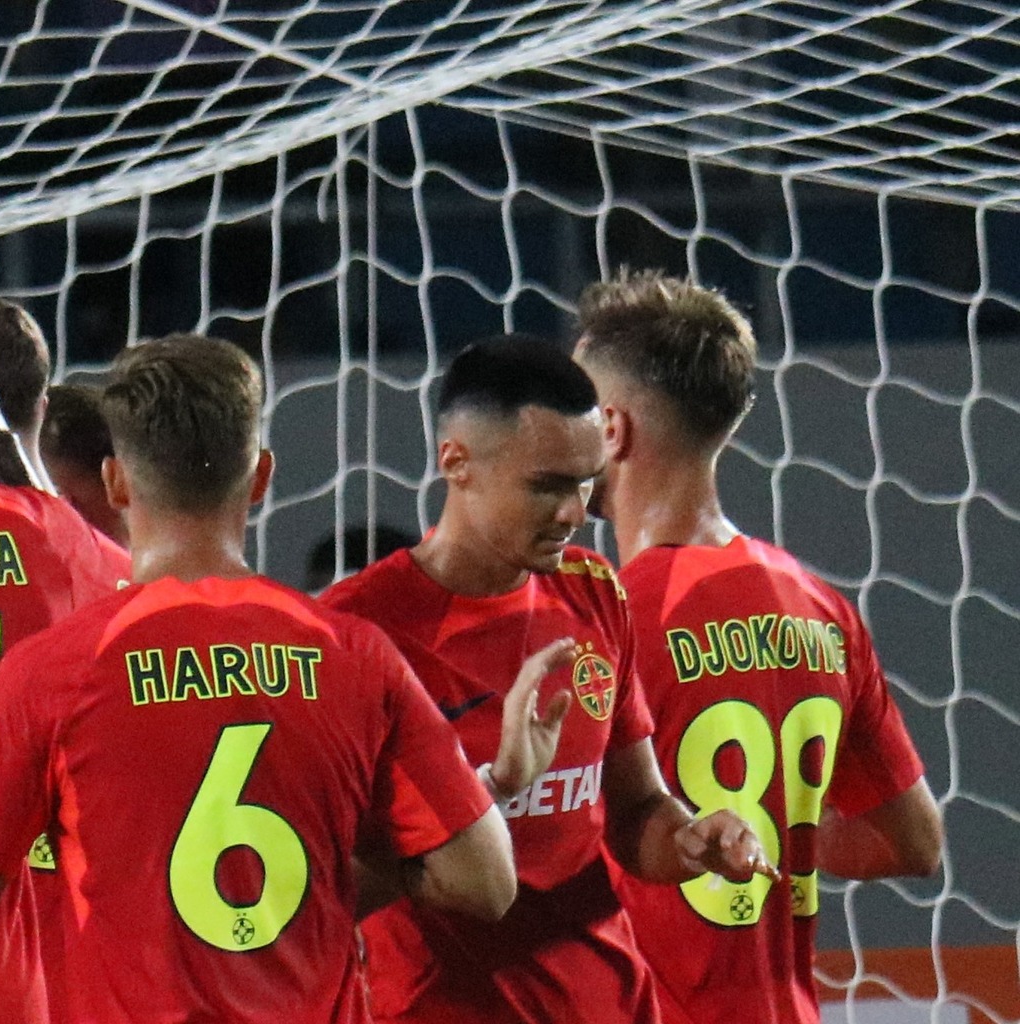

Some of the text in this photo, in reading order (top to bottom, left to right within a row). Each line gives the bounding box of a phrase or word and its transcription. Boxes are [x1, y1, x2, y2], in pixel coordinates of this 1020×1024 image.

[125, 643, 322, 706] HARUT
[667, 614, 847, 683] DJOKOVIC
[167, 721, 312, 952] 6
